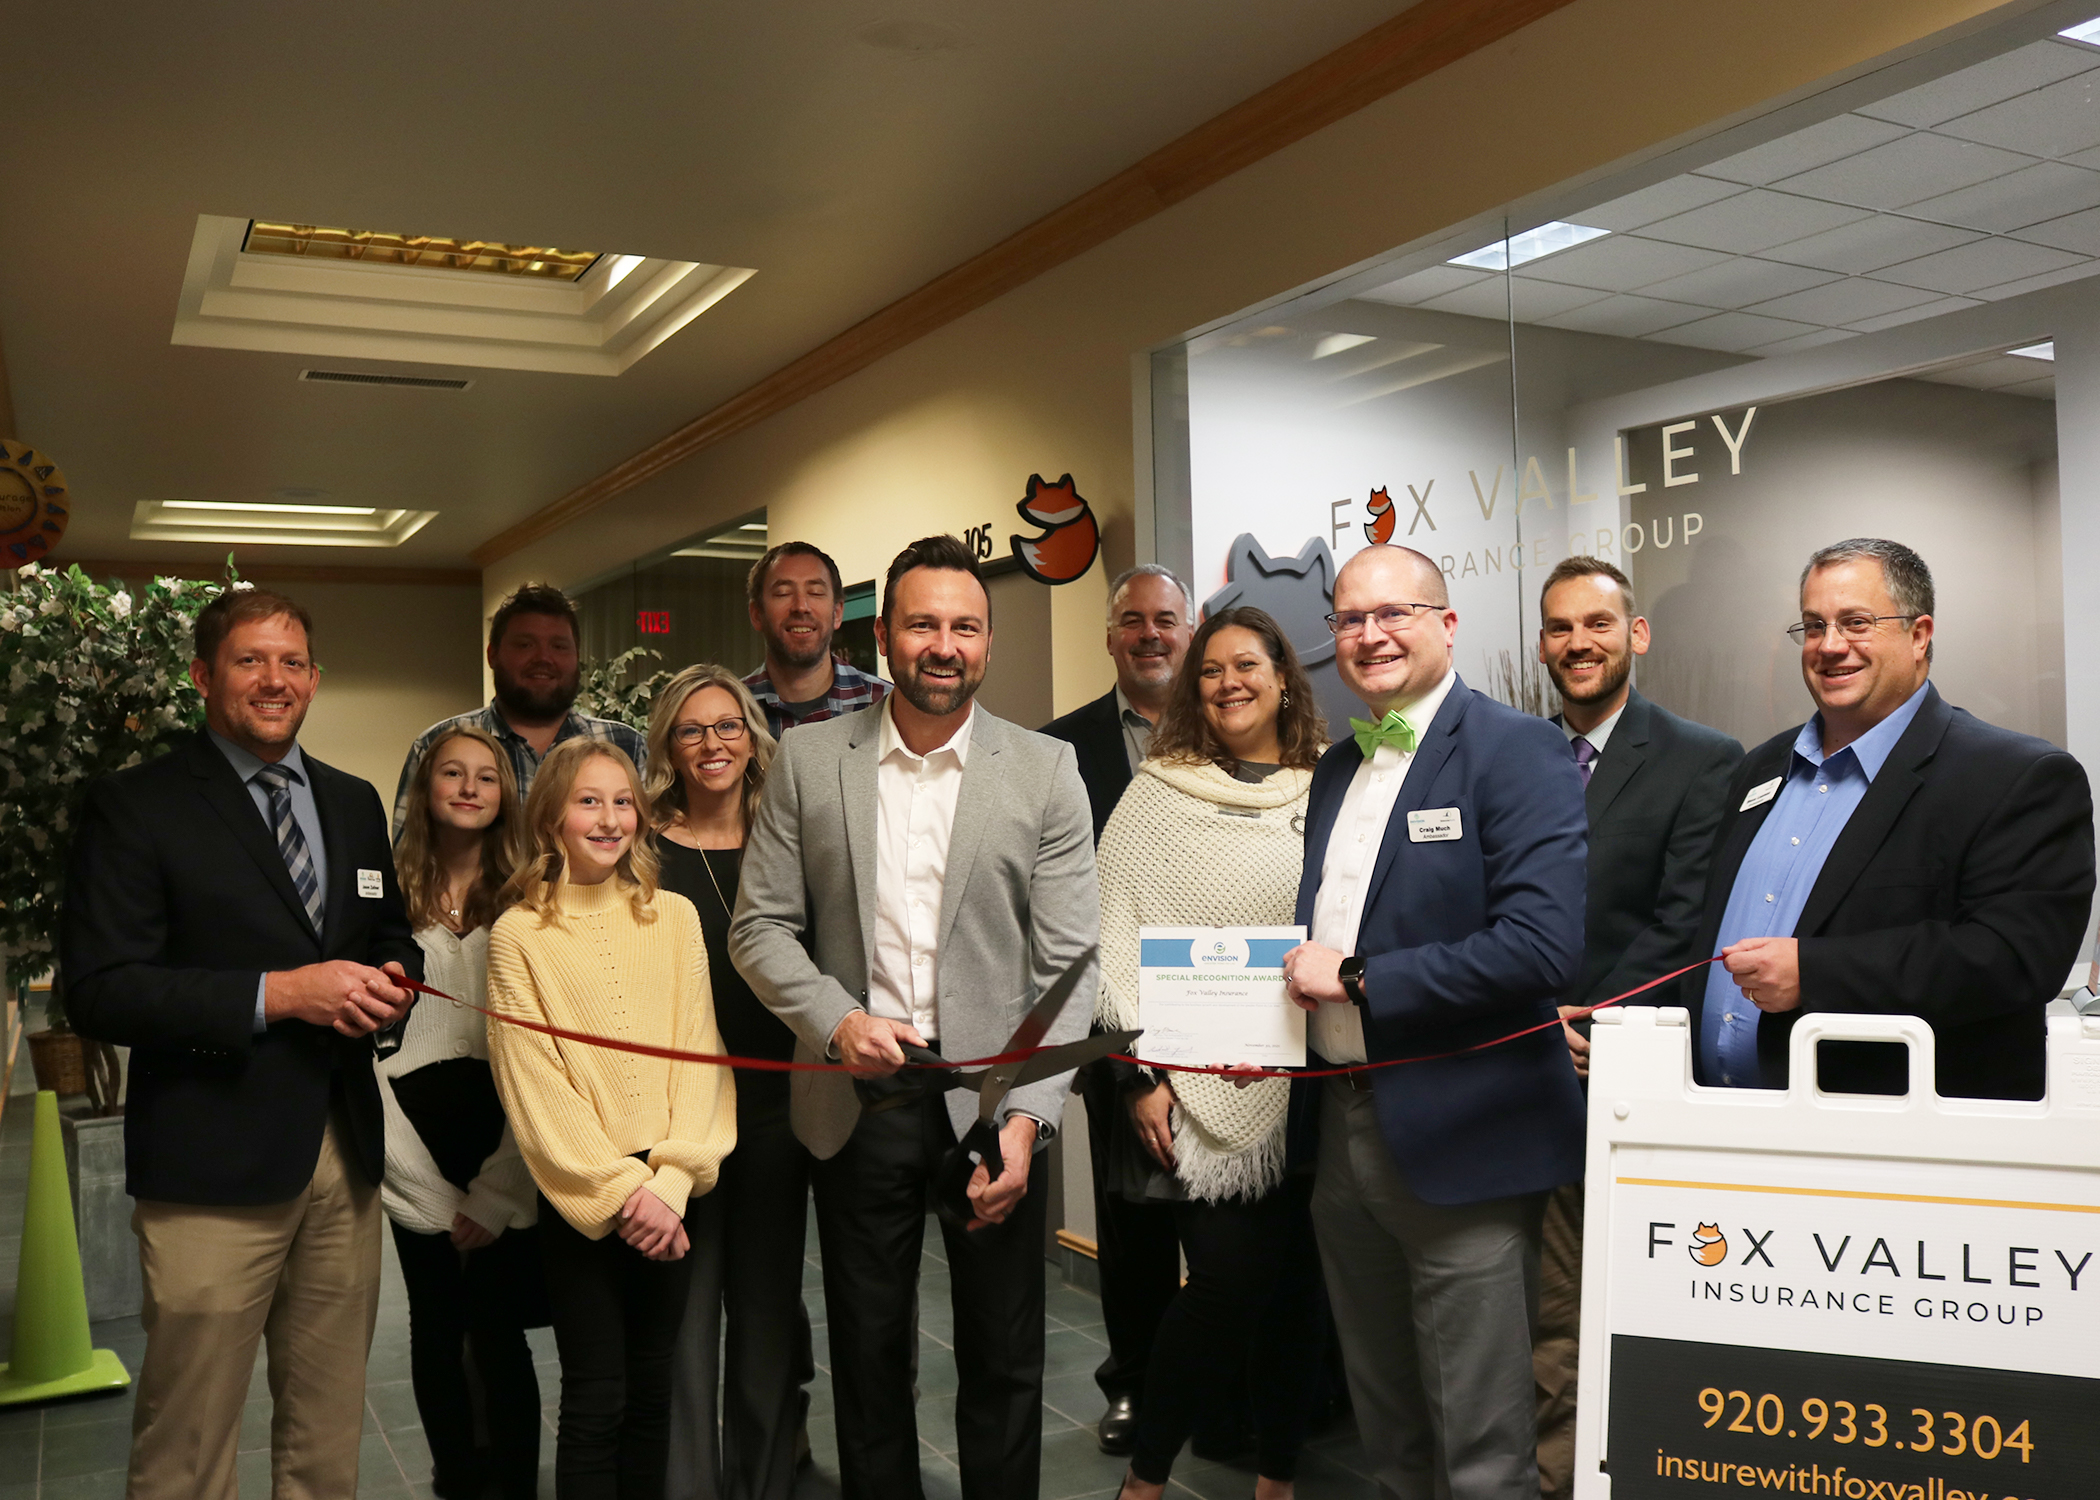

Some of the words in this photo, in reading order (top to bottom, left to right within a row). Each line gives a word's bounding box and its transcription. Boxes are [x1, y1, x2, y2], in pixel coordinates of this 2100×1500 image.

[1469, 407, 1757, 521] VALLEY
[963, 522, 993, 560] 105
[1437, 538, 1549, 580] RANCE
[1568, 513, 1704, 558] GROUP
[1185, 989, 1198, 997] Fox
[1199, 989, 1218, 997] Valley
[1192, 974, 1251, 982] RECOGNITION
[1812, 1233, 2093, 1291] VALLEY
[1691, 1279, 1895, 1316] INSURANCE
[1914, 1298, 2044, 1327] GROUP
[1698, 1387, 2035, 1464] 920.933.3304
